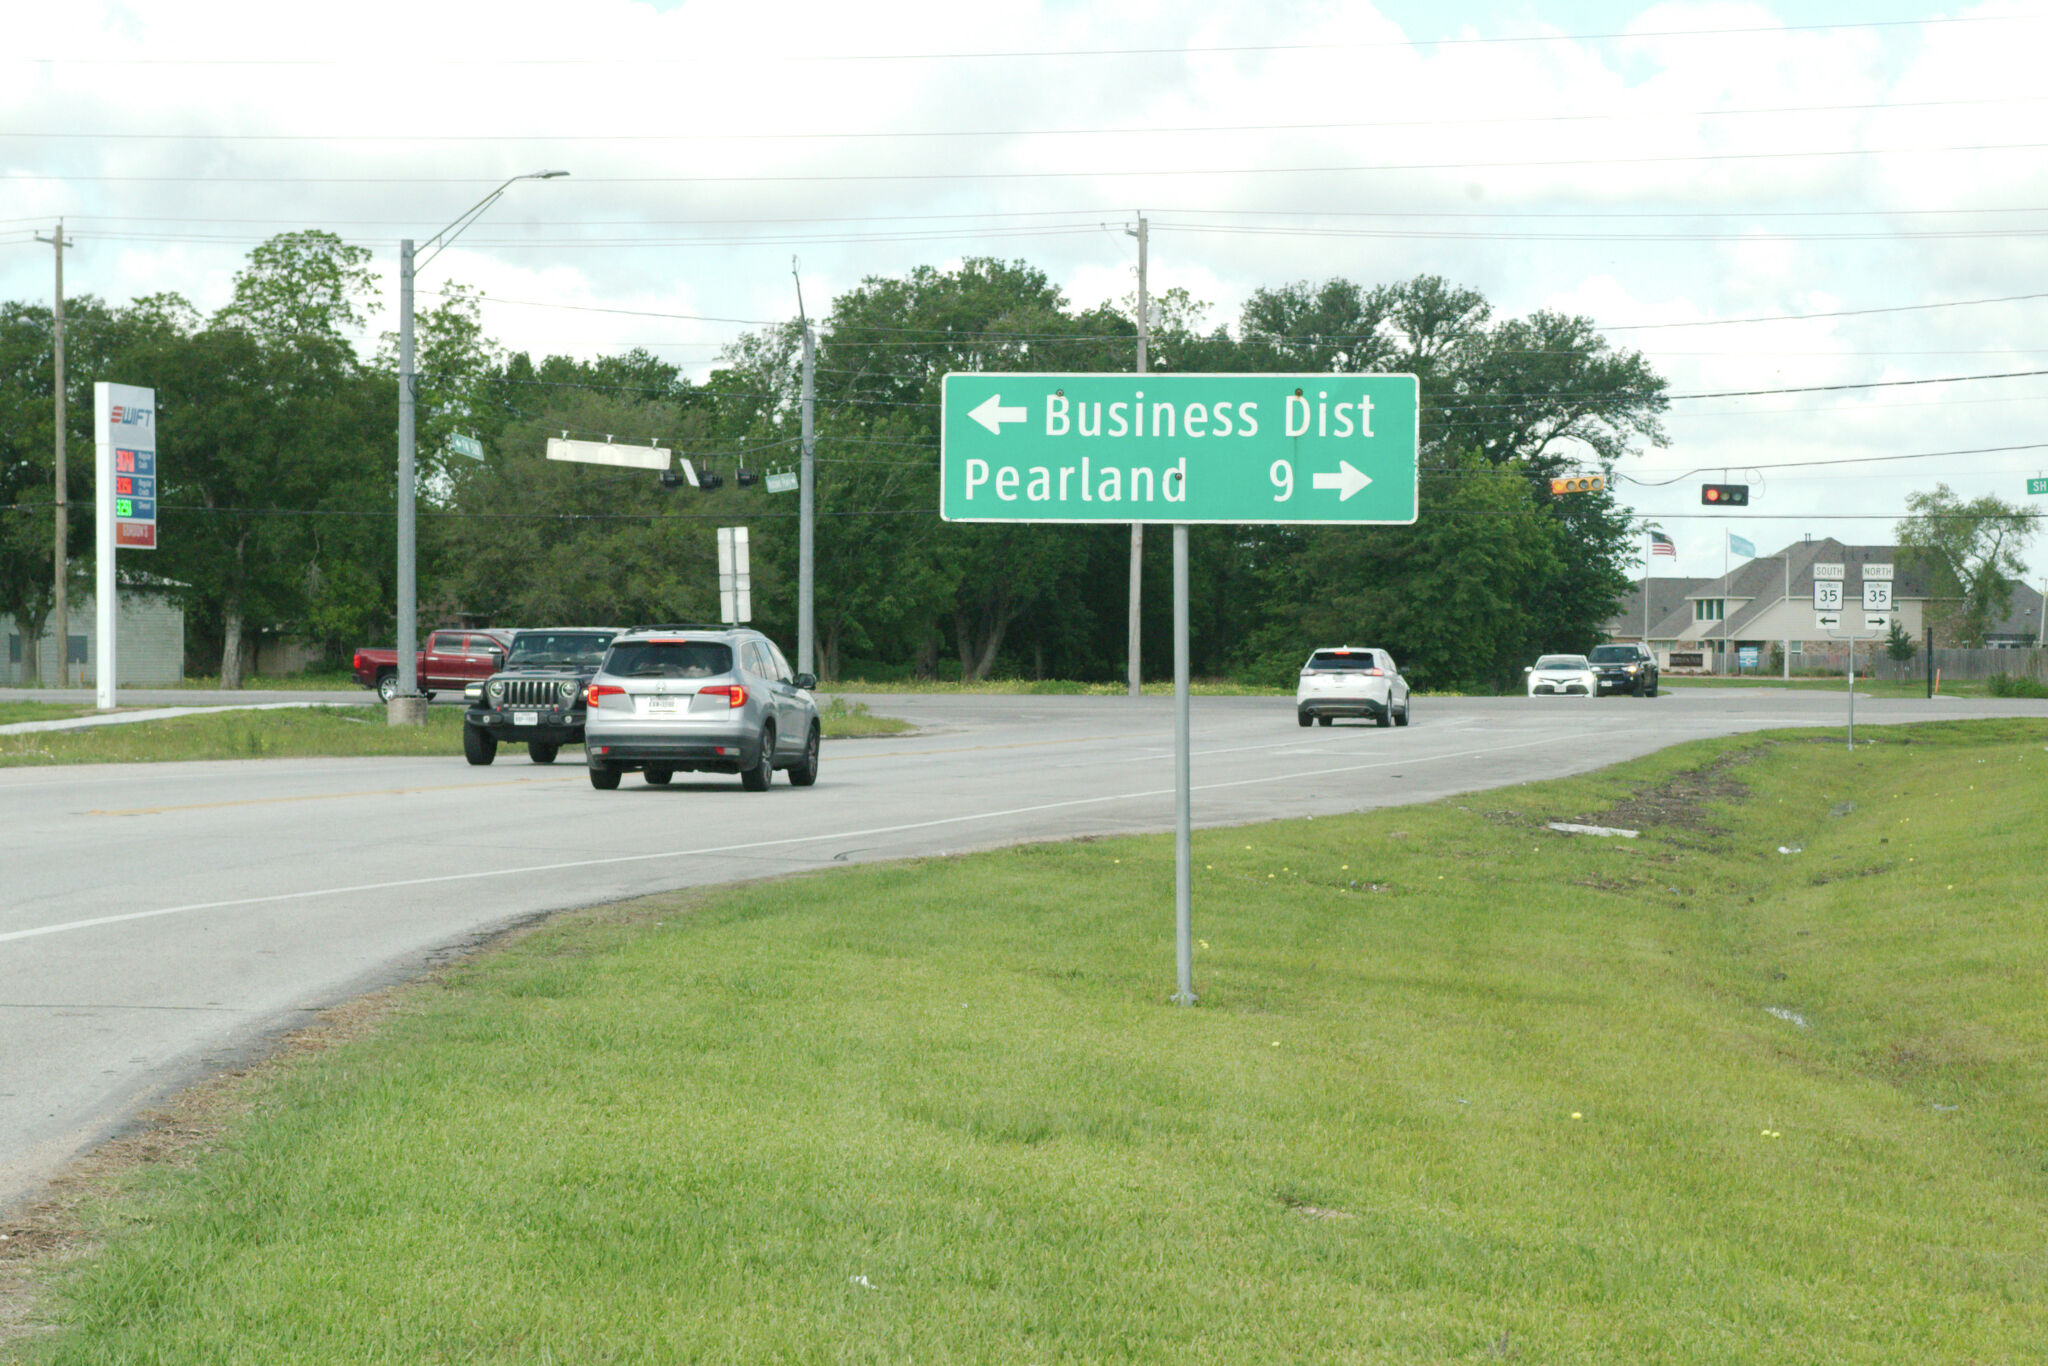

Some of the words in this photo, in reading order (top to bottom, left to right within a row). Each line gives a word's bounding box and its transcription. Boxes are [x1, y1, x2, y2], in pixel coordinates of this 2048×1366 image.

[111, 406, 153, 427] SWIFT
[1046, 391, 1259, 438] Business
[1285, 391, 1375, 438] Dist
[965, 456, 1187, 502] Pearland
[1269, 459, 1294, 502] 9
[2033, 481, 2047, 492] SH
[1816, 566, 1843, 576] SOUTH
[1864, 567, 1892, 577] NORTH
[1820, 590, 1838, 602] 35
[1868, 590, 1887, 603] 35
